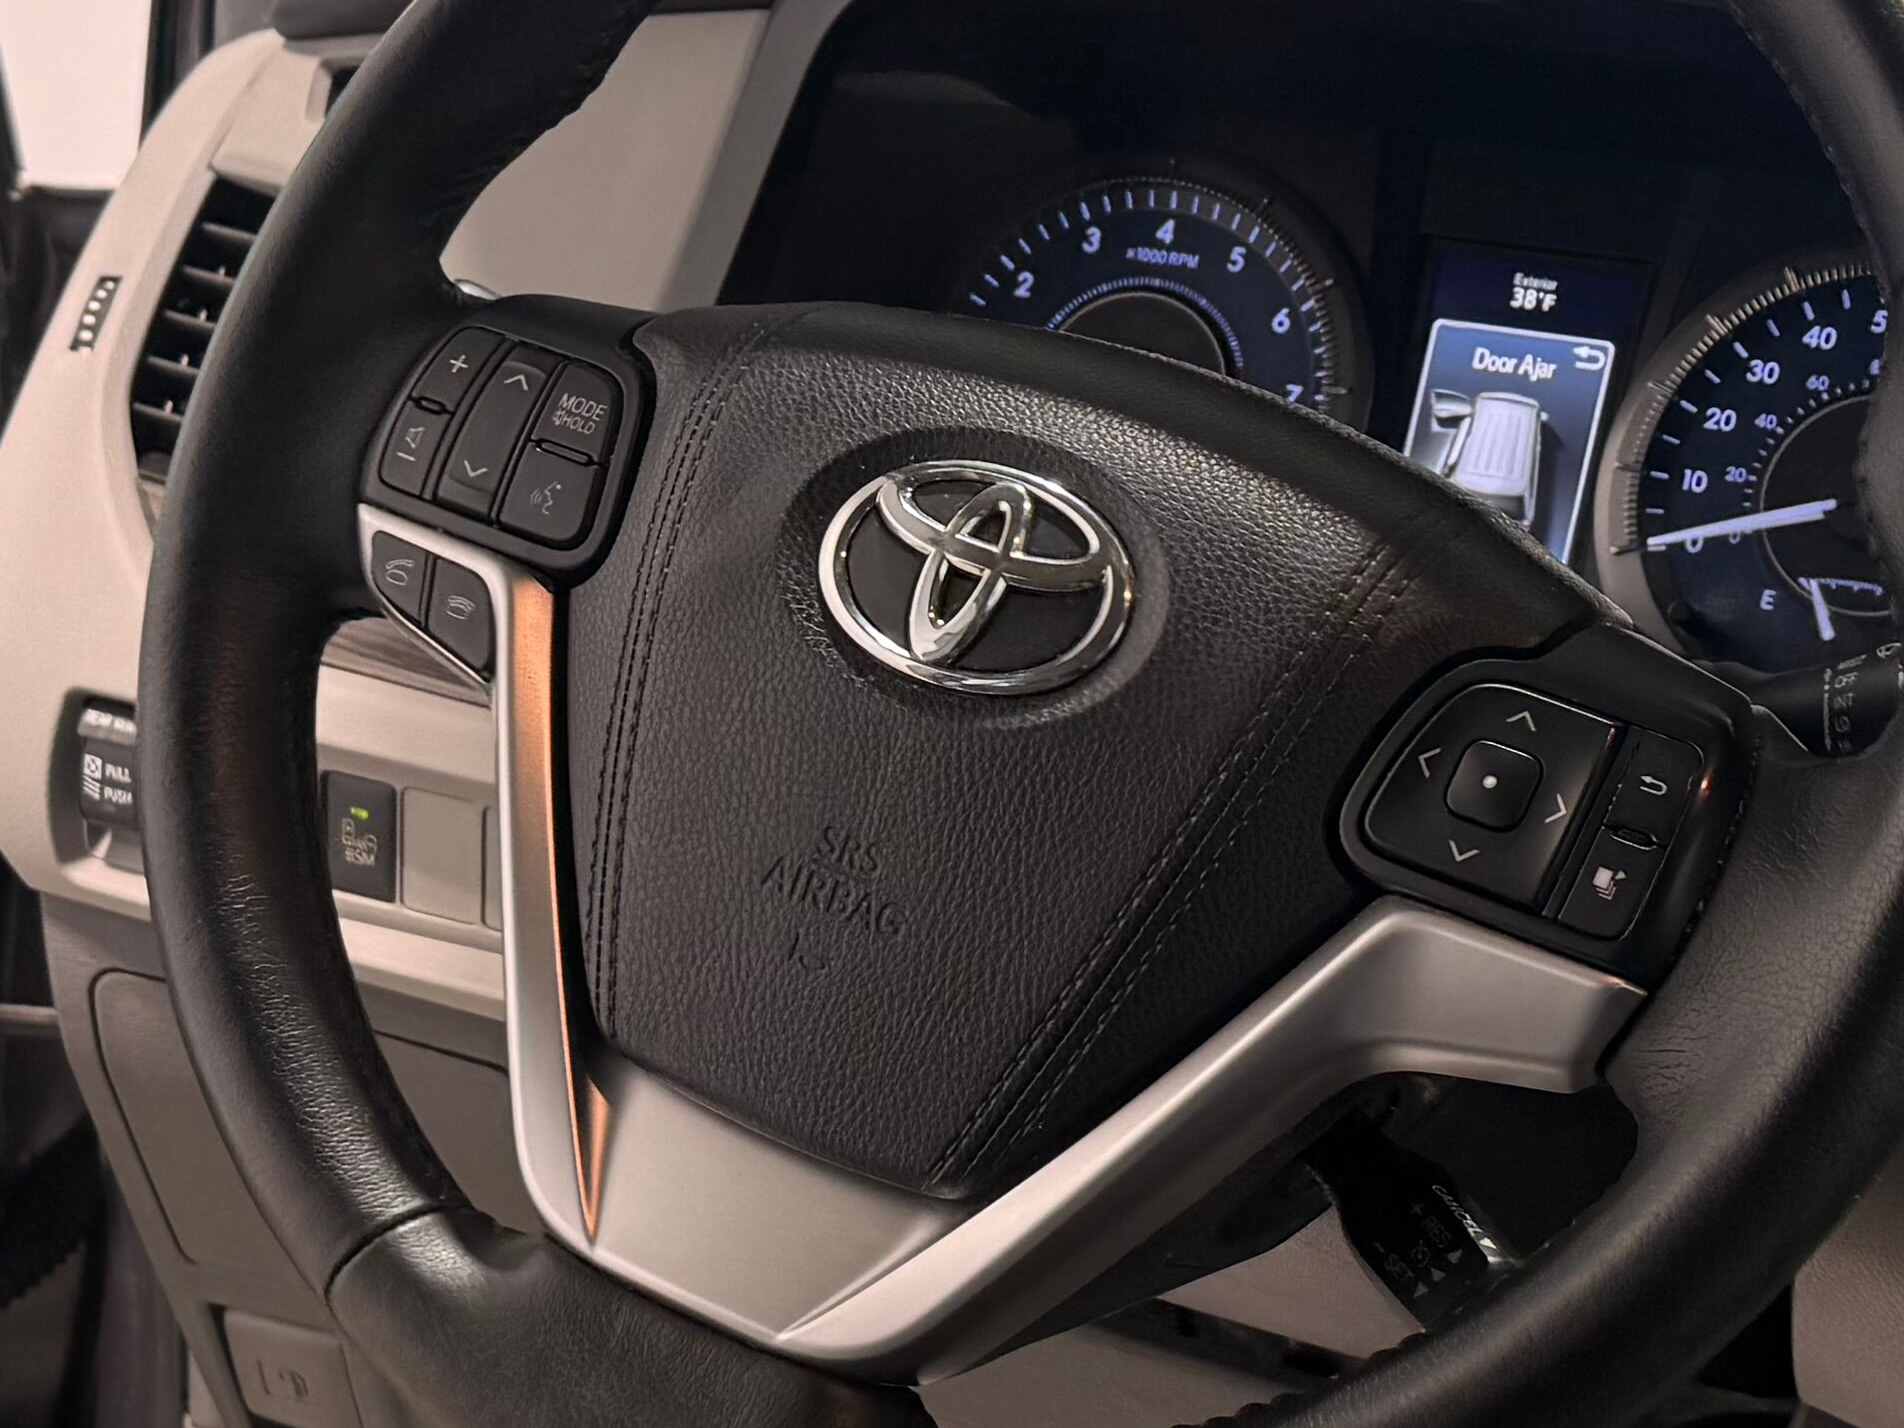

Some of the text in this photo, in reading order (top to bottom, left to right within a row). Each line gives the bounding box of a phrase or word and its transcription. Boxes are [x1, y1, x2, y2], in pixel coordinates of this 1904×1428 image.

[1081, 226, 1102, 254] 3
[1155, 219, 1175, 244] 4
[1168, 249, 1200, 269] RPM
[1226, 245, 1247, 273] 5
[1013, 271, 1035, 299] 2
[1271, 307, 1291, 334] 6
[1802, 325, 1837, 350] 40
[1474, 347, 1557, 382] Door Ajar
[1745, 359, 1781, 385] 30
[1806, 375, 1830, 391] 60
[558, 393, 608, 421] MODE
[1703, 407, 1737, 432] 20
[562, 414, 596, 434] HOLD
[1754, 413, 1777, 429] 40
[1682, 468, 1708, 493] 10
[1724, 466, 1747, 483] 20
[1760, 589, 1776, 611] E
[816, 826, 878, 872] SRS
[761, 855, 901, 935] AIRBAG
